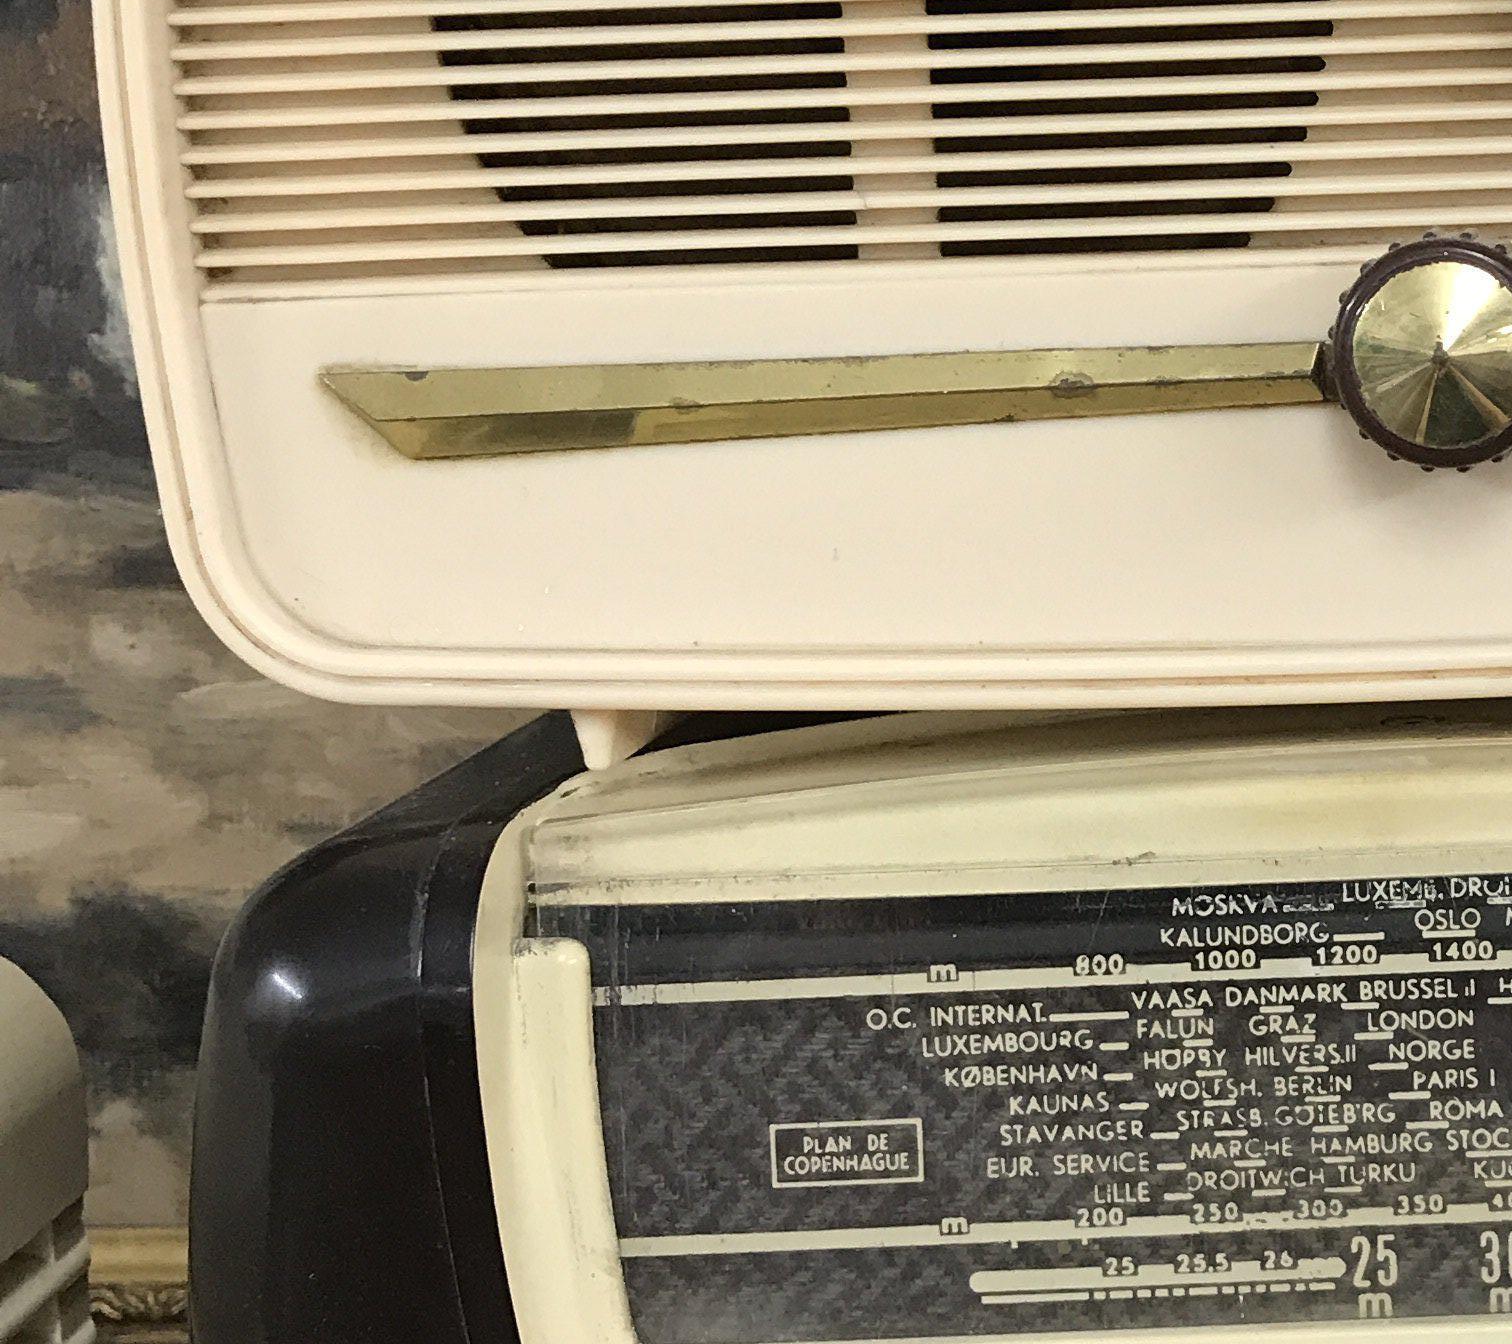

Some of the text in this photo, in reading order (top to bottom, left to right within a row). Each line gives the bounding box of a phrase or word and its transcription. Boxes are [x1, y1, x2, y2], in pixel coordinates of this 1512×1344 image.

[1171, 893, 1278, 918] MOSKVA
[1414, 907, 1481, 931] OSLO
[1160, 921, 1330, 948] KALUNDBORG
[1074, 954, 1124, 976] 800
[1194, 948, 1257, 970] 1000
[1316, 944, 1378, 966] 1200
[1431, 940, 1495, 961] 1400
[1131, 986, 1214, 1010] VAASA
[1225, 983, 1348, 1007] DANMARK
[1359, 977, 1458, 1001] BRUSSEL
[1136, 1017, 1214, 1039] FALUN
[1248, 1012, 1317, 1036] GRAZ
[1367, 1007, 1475, 1032] LONDON
[921, 1029, 1095, 1058] LUXEMBOURG
[1388, 1037, 1476, 1061] NORGE
[944, 1060, 1099, 1088] KØBENHAVN
[1273, 1073, 1352, 1096] BERLIN
[1413, 1067, 1479, 1091] PARIS
[1009, 1091, 1110, 1117] KAUNAS
[1429, 1096, 1504, 1122] ROMA
[803, 1132, 889, 1156] PLAN DE
[1000, 1120, 1144, 1147] STAVANGER
[1190, 1135, 1294, 1160] MARCHE
[1310, 1131, 1433, 1156] HAMBURG
[783, 1152, 910, 1175] COPENHAGUE
[986, 1150, 1150, 1178] EUR. SERVICE
[1186, 1165, 1324, 1192] DROITWICH
[1338, 1161, 1416, 1186] TURKU
[1094, 1181, 1150, 1205] LILLE
[1076, 1207, 1124, 1228] 200
[1191, 1201, 1239, 1224] 250
[1297, 1197, 1343, 1220] 300
[1396, 1193, 1444, 1215] 350
[1104, 1255, 1135, 1277] 25
[1176, 1252, 1229, 1274] 25.5
[1263, 1250, 1294, 1270] 26
[1350, 1233, 1398, 1287] 25
